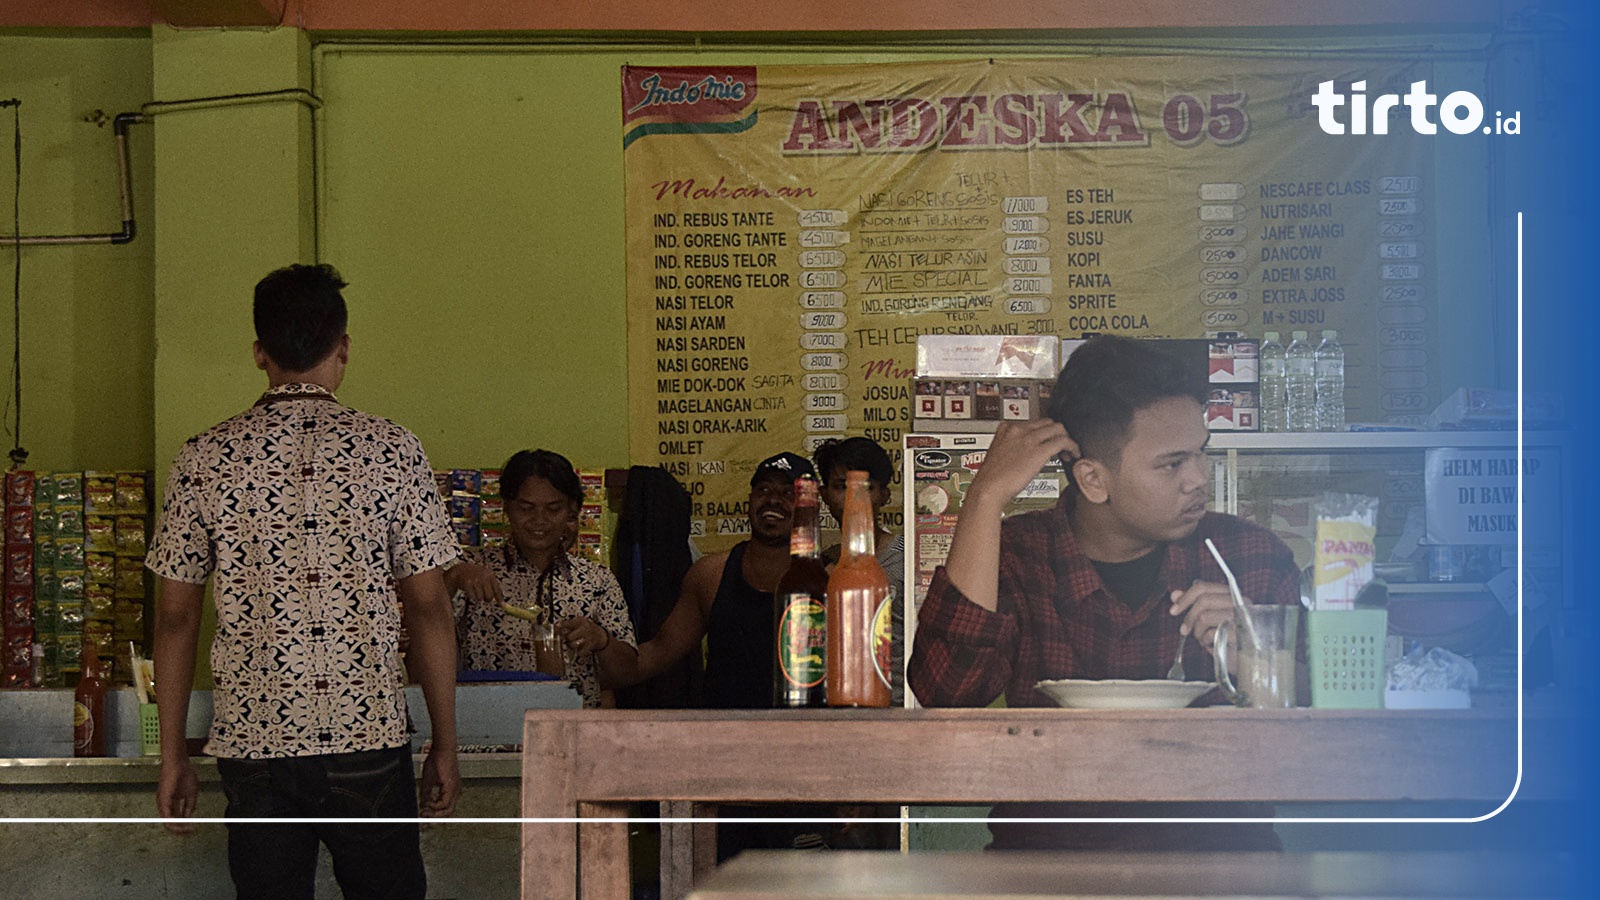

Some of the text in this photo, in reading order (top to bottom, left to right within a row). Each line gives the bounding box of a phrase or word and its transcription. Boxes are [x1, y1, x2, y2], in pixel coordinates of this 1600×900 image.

[782, 90, 1249, 157] ANDESKA 05
[651, 176, 818, 201] Makanan
[1259, 180, 1371, 198] NESCAFE CLASS
[1383, 178, 1417, 192] 2500
[1066, 189, 1114, 204] ES TEH
[654, 211, 774, 227] IND. REBUS TANTE
[1066, 209, 1133, 225] ES JERUK
[1260, 203, 1332, 219] NUTRISARI
[654, 232, 787, 248] IND. GORENG TANTE
[1067, 231, 1104, 246] SUSU
[1204, 227, 1235, 240] 3000
[1260, 223, 1345, 241] JAHE WANGI
[655, 253, 777, 269] IND. REBUS TELOR
[864, 253, 902, 269] NASI
[909, 252, 953, 267] TELUR
[1067, 252, 1100, 267] KOPI
[1205, 250, 1236, 262] 2500
[1261, 246, 1322, 262] DANCOW
[655, 274, 790, 290] IND. GORENG TELOR
[912, 271, 988, 288] SPECIAL
[1068, 273, 1112, 288] FANTA
[1205, 271, 1239, 284] 5000
[1261, 266, 1336, 283] ADEM SARI
[656, 295, 734, 310] NASI TELOR
[1068, 294, 1117, 309] SPRITE
[1206, 291, 1238, 304] 5000
[1262, 287, 1345, 304] EXTRA JOSS
[656, 316, 726, 331] NASI AYAM
[1069, 314, 1150, 331] COCA COLA
[1207, 312, 1238, 325] 5000
[1263, 310, 1274, 325] M
[1289, 309, 1325, 324] SUSU
[657, 336, 746, 351] NASI SARDEN
[854, 328, 889, 348] TEH
[657, 357, 749, 372] NASI GORENG
[658, 377, 746, 393] MIE DOK-DOK
[863, 385, 909, 401] JOSUA
[658, 398, 752, 414] MAGELANGAN
[863, 407, 897, 422] MILO
[658, 418, 767, 434] NASI ORAK-ARIK
[864, 428, 900, 442] SUSU
[659, 441, 704, 455] OMLET
[697, 460, 726, 475] IKAN
[1443, 458, 1540, 477] HELM HARAP
[1458, 486, 1526, 504] DI BAW
[707, 501, 751, 516] BALAD
[1467, 514, 1519, 532] MASUK
